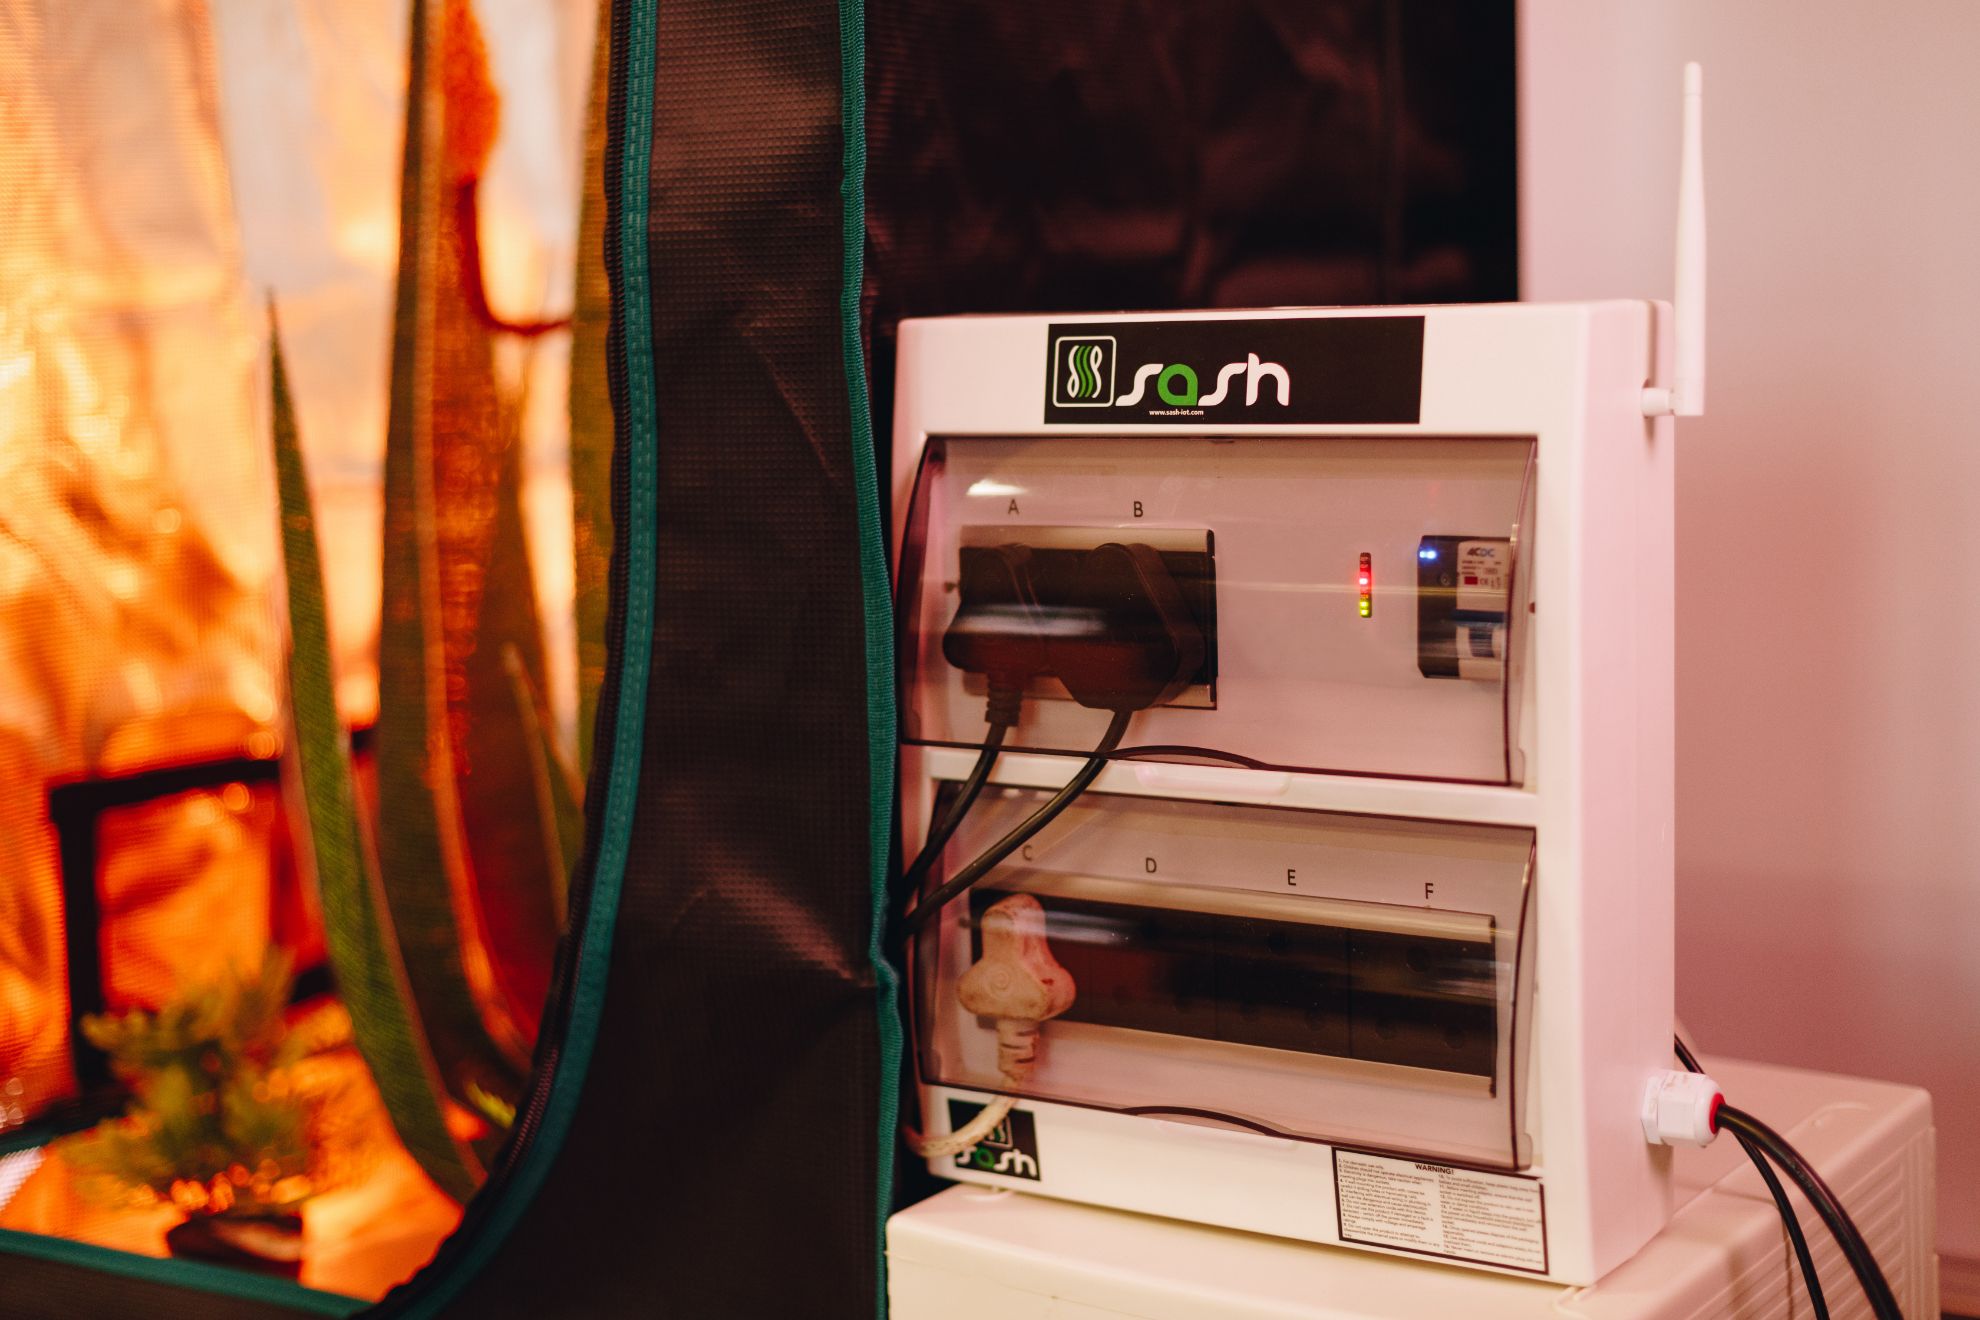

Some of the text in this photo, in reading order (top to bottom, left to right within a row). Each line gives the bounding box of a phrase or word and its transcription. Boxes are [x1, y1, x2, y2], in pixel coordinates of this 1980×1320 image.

[1115, 353, 1290, 407] sash
[1008, 498, 1020, 515] A
[1133, 501, 1144, 518] B
[1022, 846, 1033, 862] C
[1146, 857, 1158, 874] D
[1287, 869, 1298, 887] E
[1425, 883, 1434, 901] F
[1415, 1164, 1454, 1175] WARNING!
